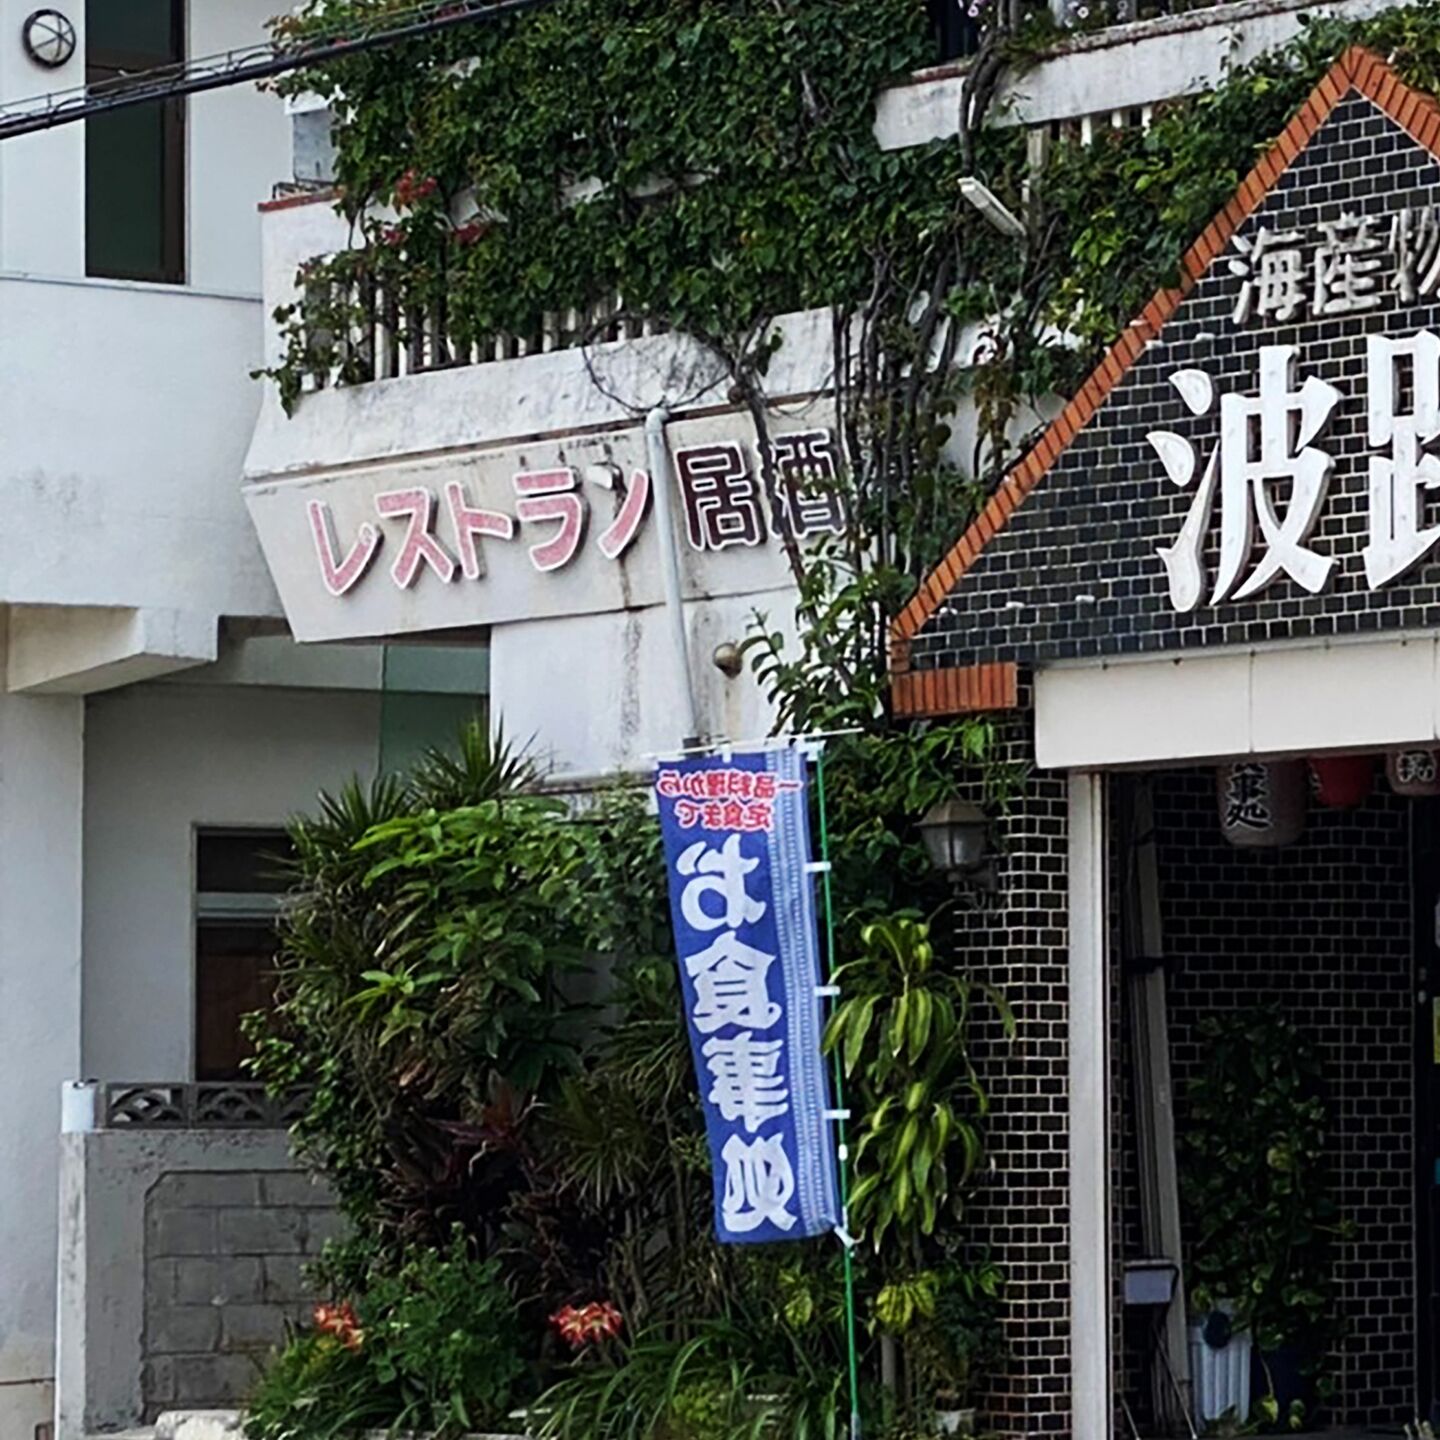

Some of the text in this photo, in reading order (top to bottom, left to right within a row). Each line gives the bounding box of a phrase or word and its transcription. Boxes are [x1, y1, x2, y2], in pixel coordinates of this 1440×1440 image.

[308, 467, 650, 596] レストラン
